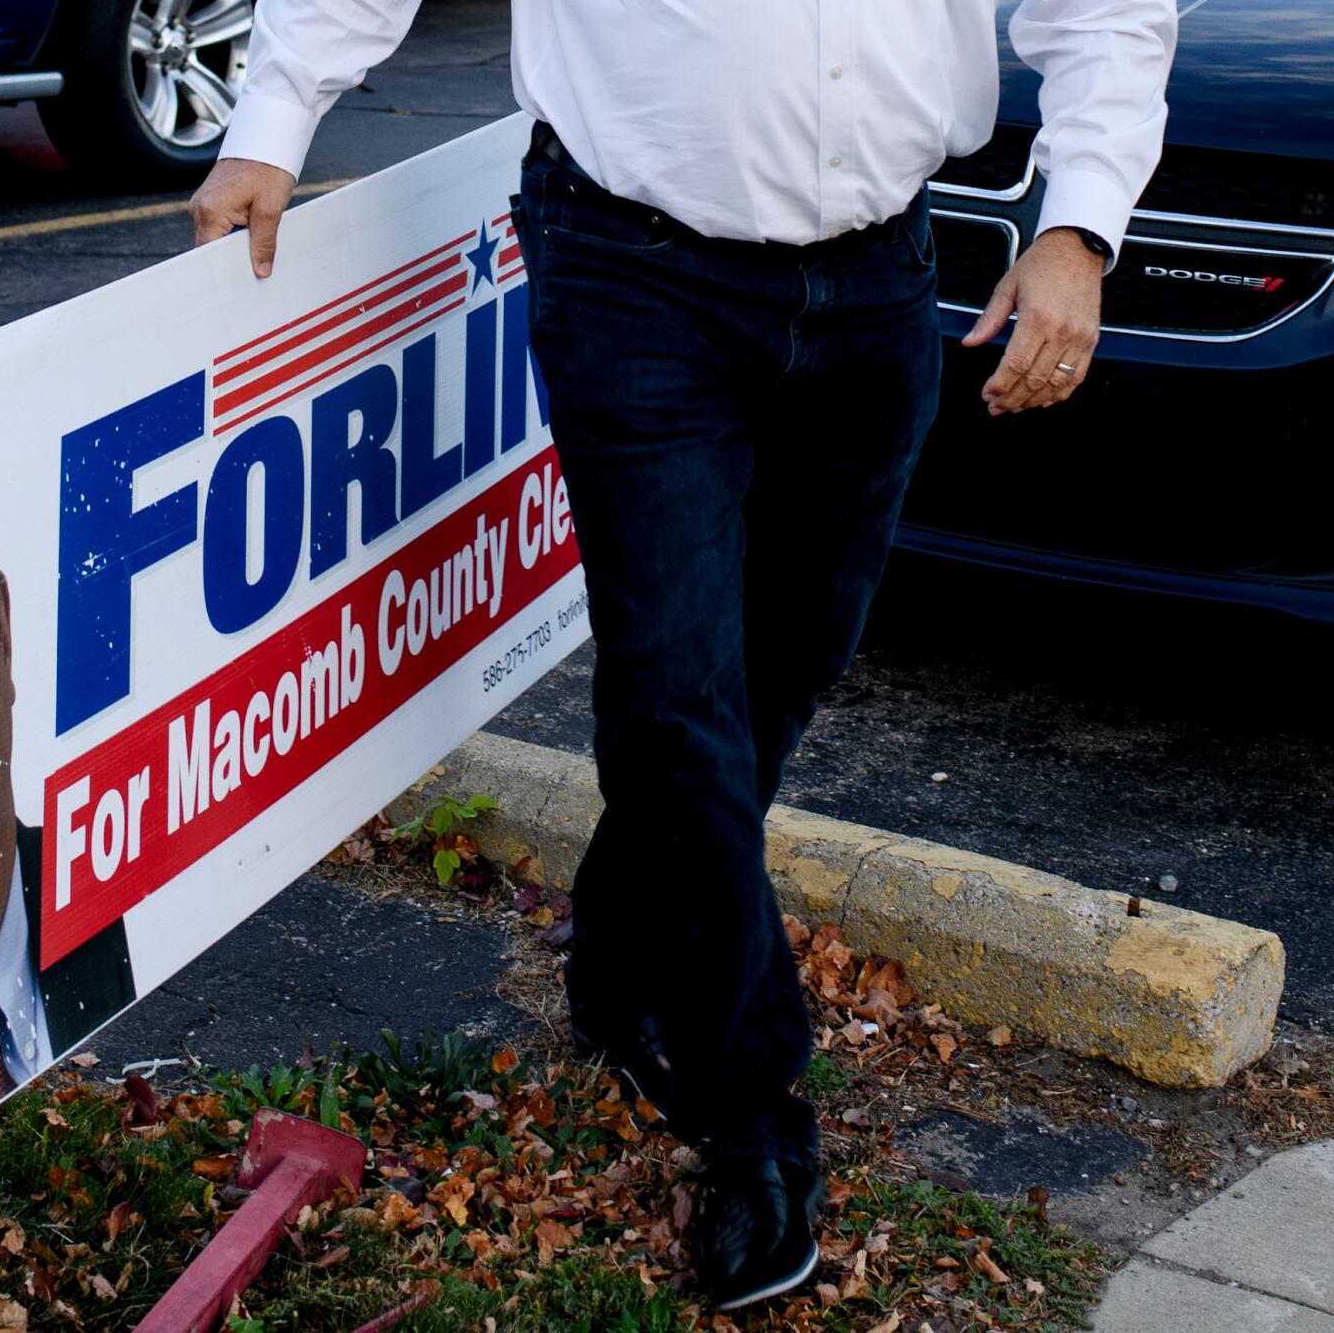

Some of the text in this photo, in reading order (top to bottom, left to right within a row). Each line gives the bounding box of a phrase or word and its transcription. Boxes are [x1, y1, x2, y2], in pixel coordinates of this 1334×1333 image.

[1144, 266, 1266, 288] DODGE
[55, 463, 576, 911] For Macomb County Cle
[483, 621, 552, 692] 586-275-7703
